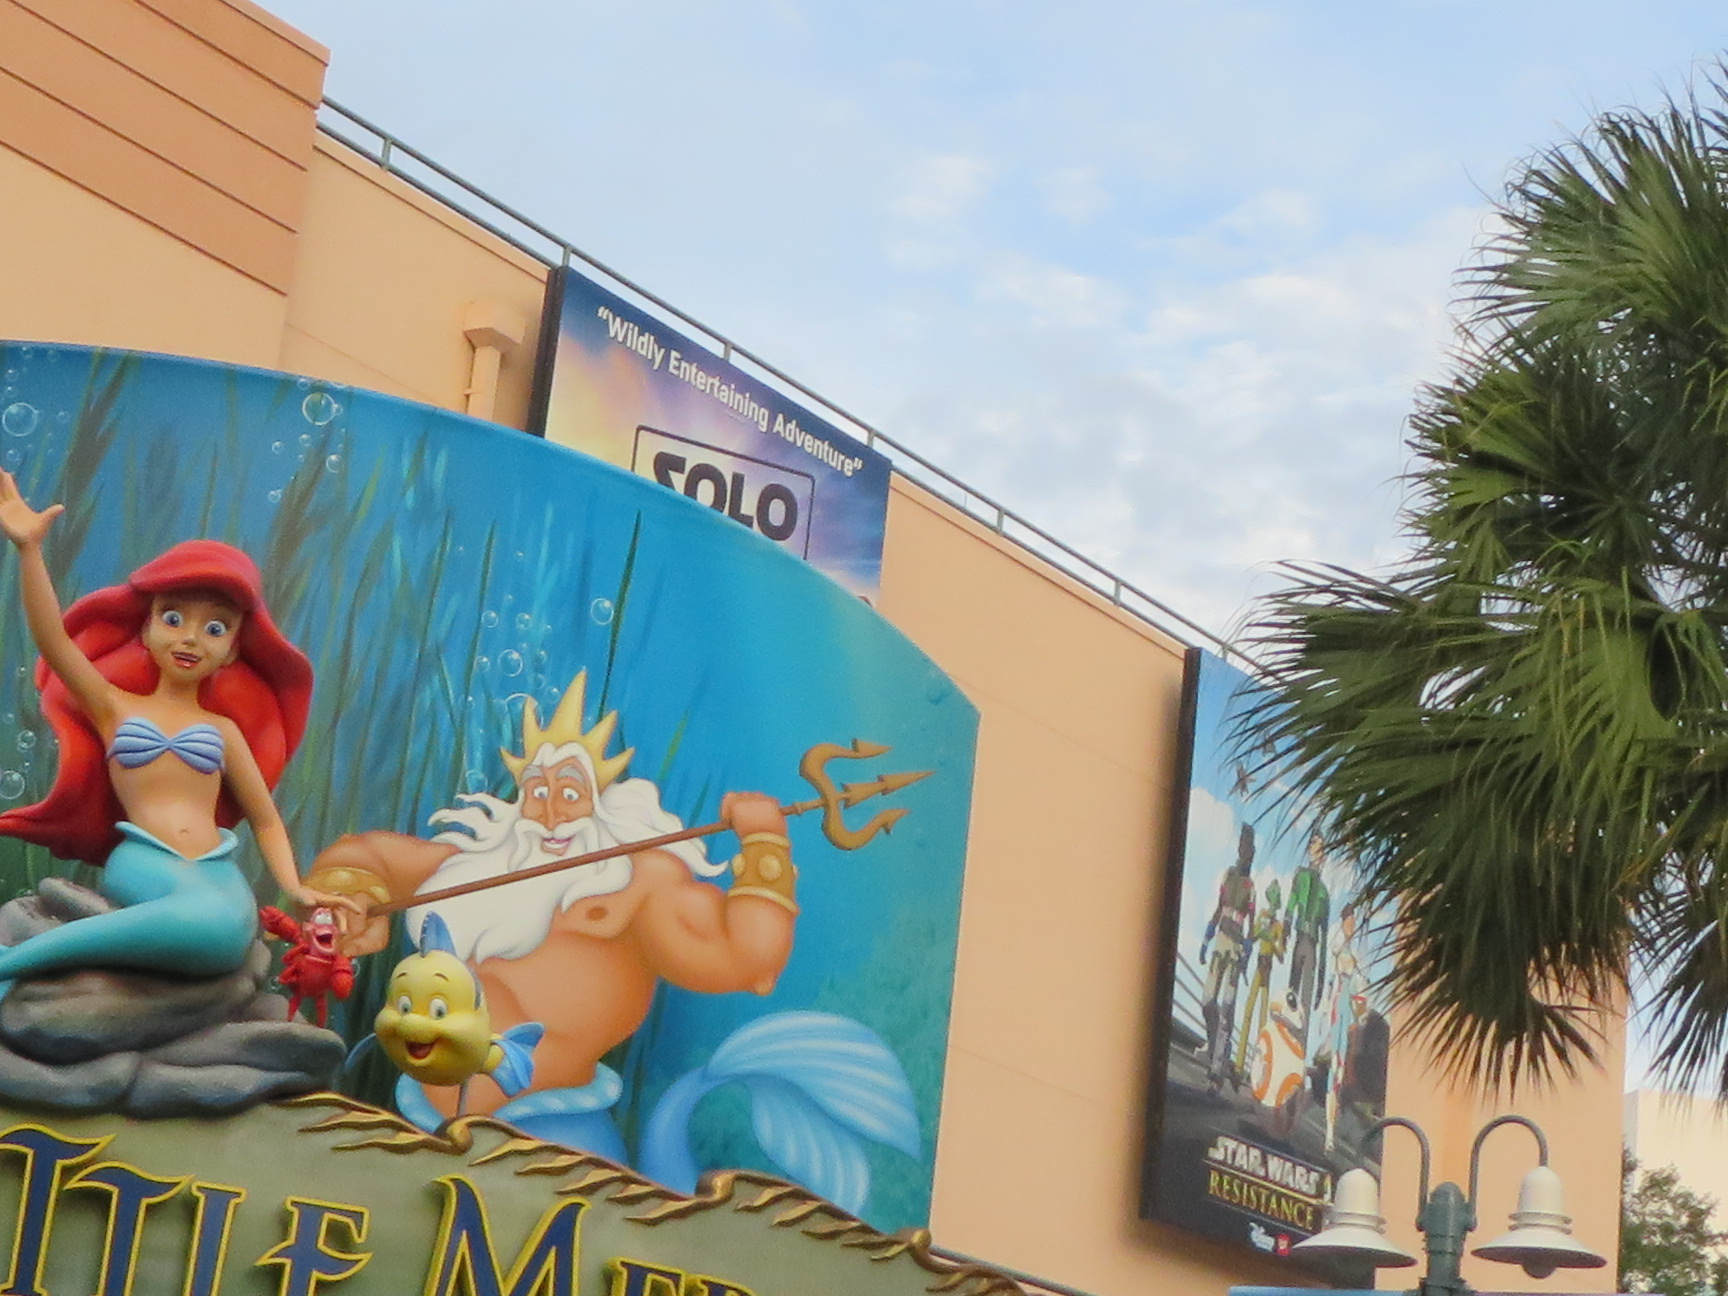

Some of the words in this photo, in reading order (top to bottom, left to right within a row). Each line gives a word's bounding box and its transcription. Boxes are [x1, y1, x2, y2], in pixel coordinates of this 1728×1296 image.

[669, 350, 769, 433] Entertaining
[653, 451, 798, 541] SOLO
[1208, 1135, 1266, 1177] STAR
[1266, 1153, 1320, 1195] WARS
[1208, 1169, 1313, 1231] RESISTANCE
